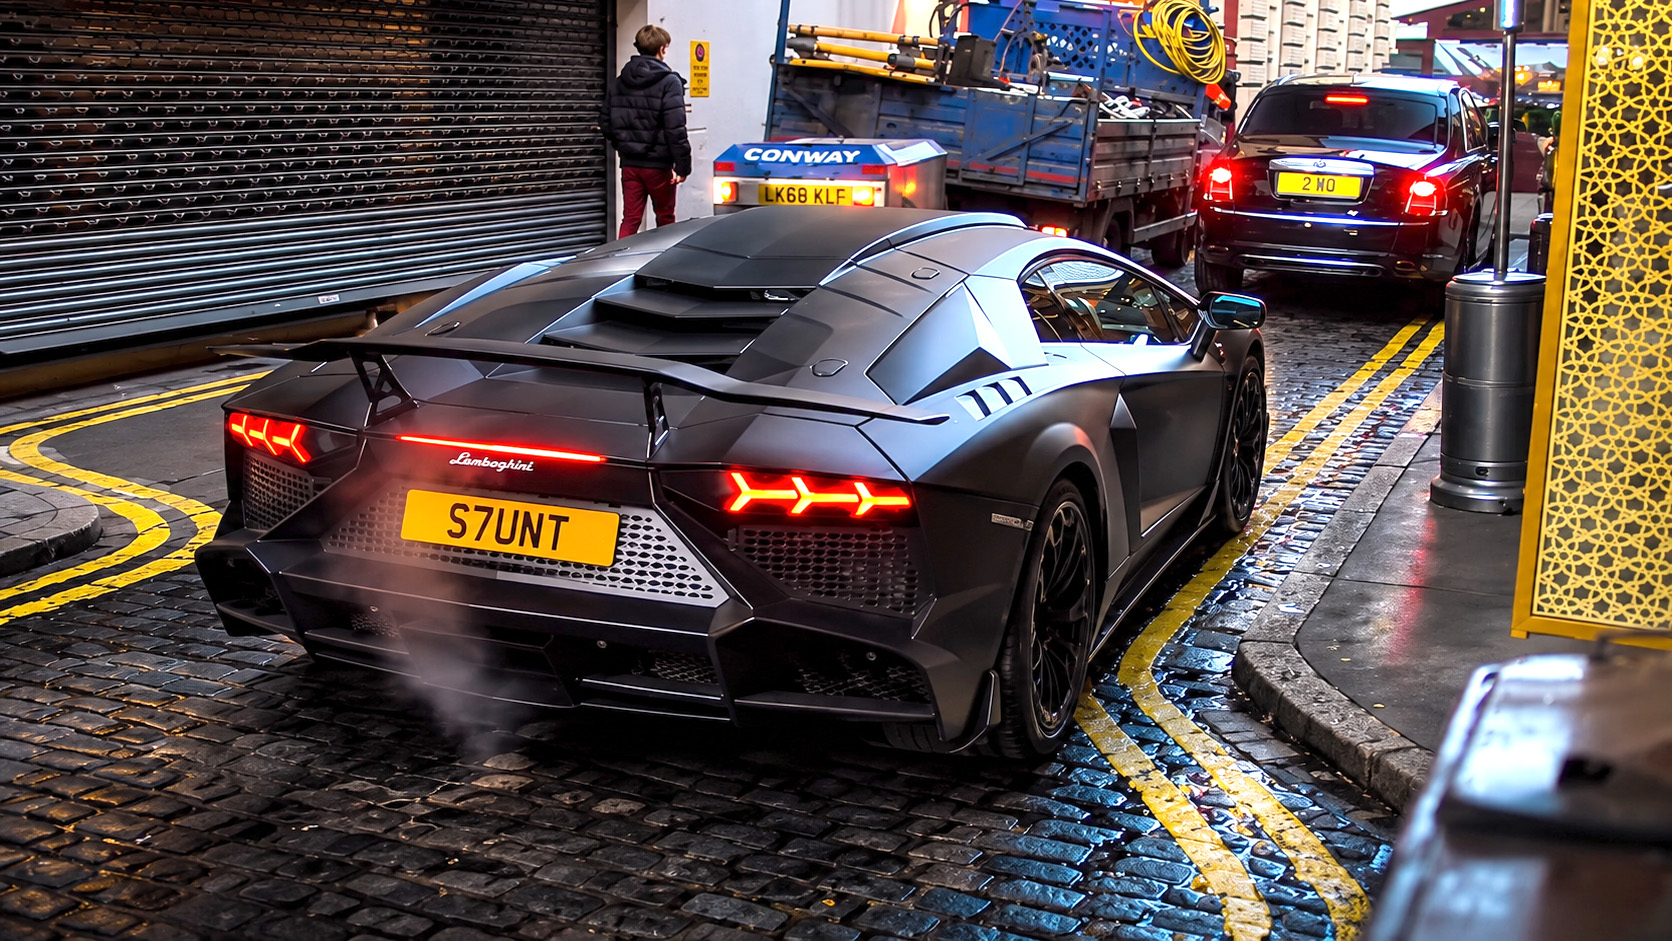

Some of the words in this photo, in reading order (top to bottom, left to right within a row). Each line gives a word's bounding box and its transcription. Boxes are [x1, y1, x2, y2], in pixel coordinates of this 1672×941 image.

[744, 148, 861, 163] CONWAY
[1302, 176, 1311, 191] 2
[764, 186, 807, 203] LK68
[814, 188, 846, 205] KLF
[449, 451, 534, 472] Lamborghini
[447, 502, 569, 551] S7UNT
